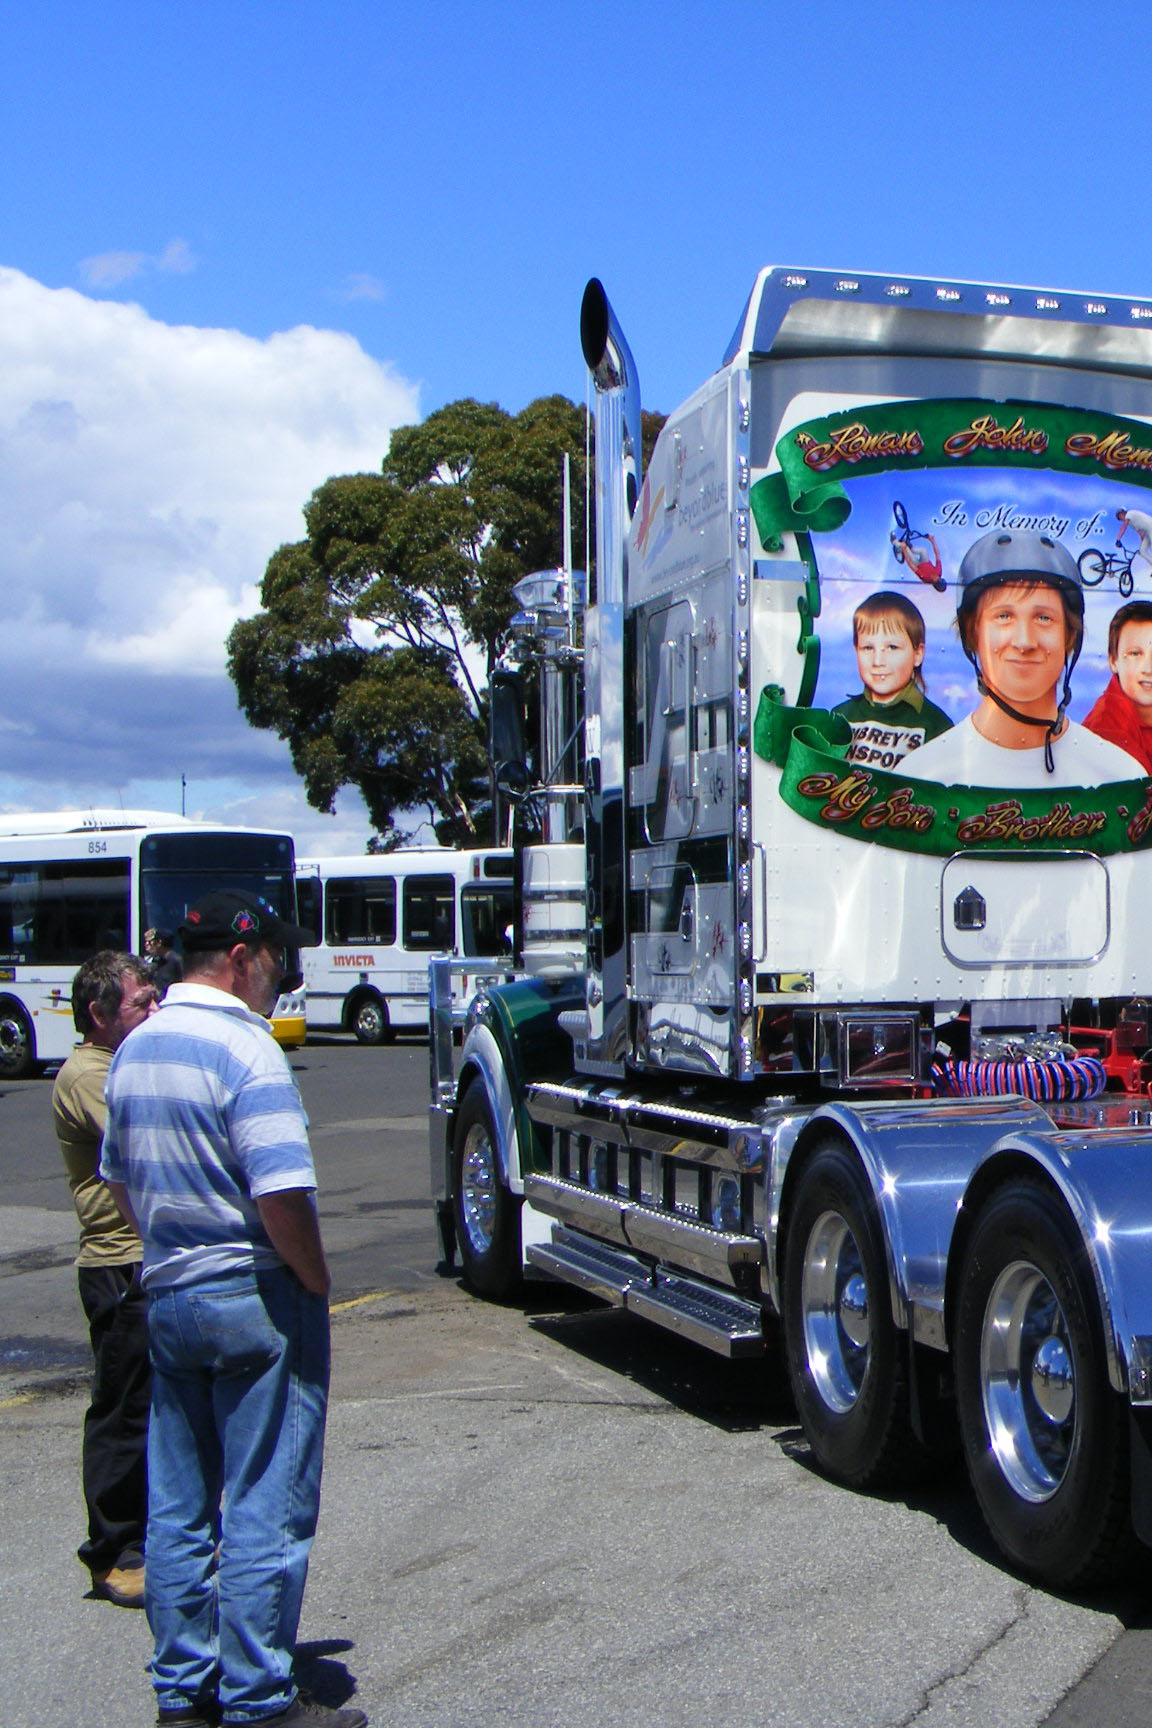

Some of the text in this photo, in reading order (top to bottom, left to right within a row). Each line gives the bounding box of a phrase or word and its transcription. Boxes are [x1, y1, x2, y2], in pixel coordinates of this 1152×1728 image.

[945, 415, 1049, 459] John
[933, 500, 968, 526] In
[976, 503, 1069, 539] Memory
[797, 770, 878, 822] My
[861, 787, 936, 834] Son
[957, 799, 1107, 843] Brother
[88, 841, 107, 853] 854
[333, 954, 375, 967] INVICTA
